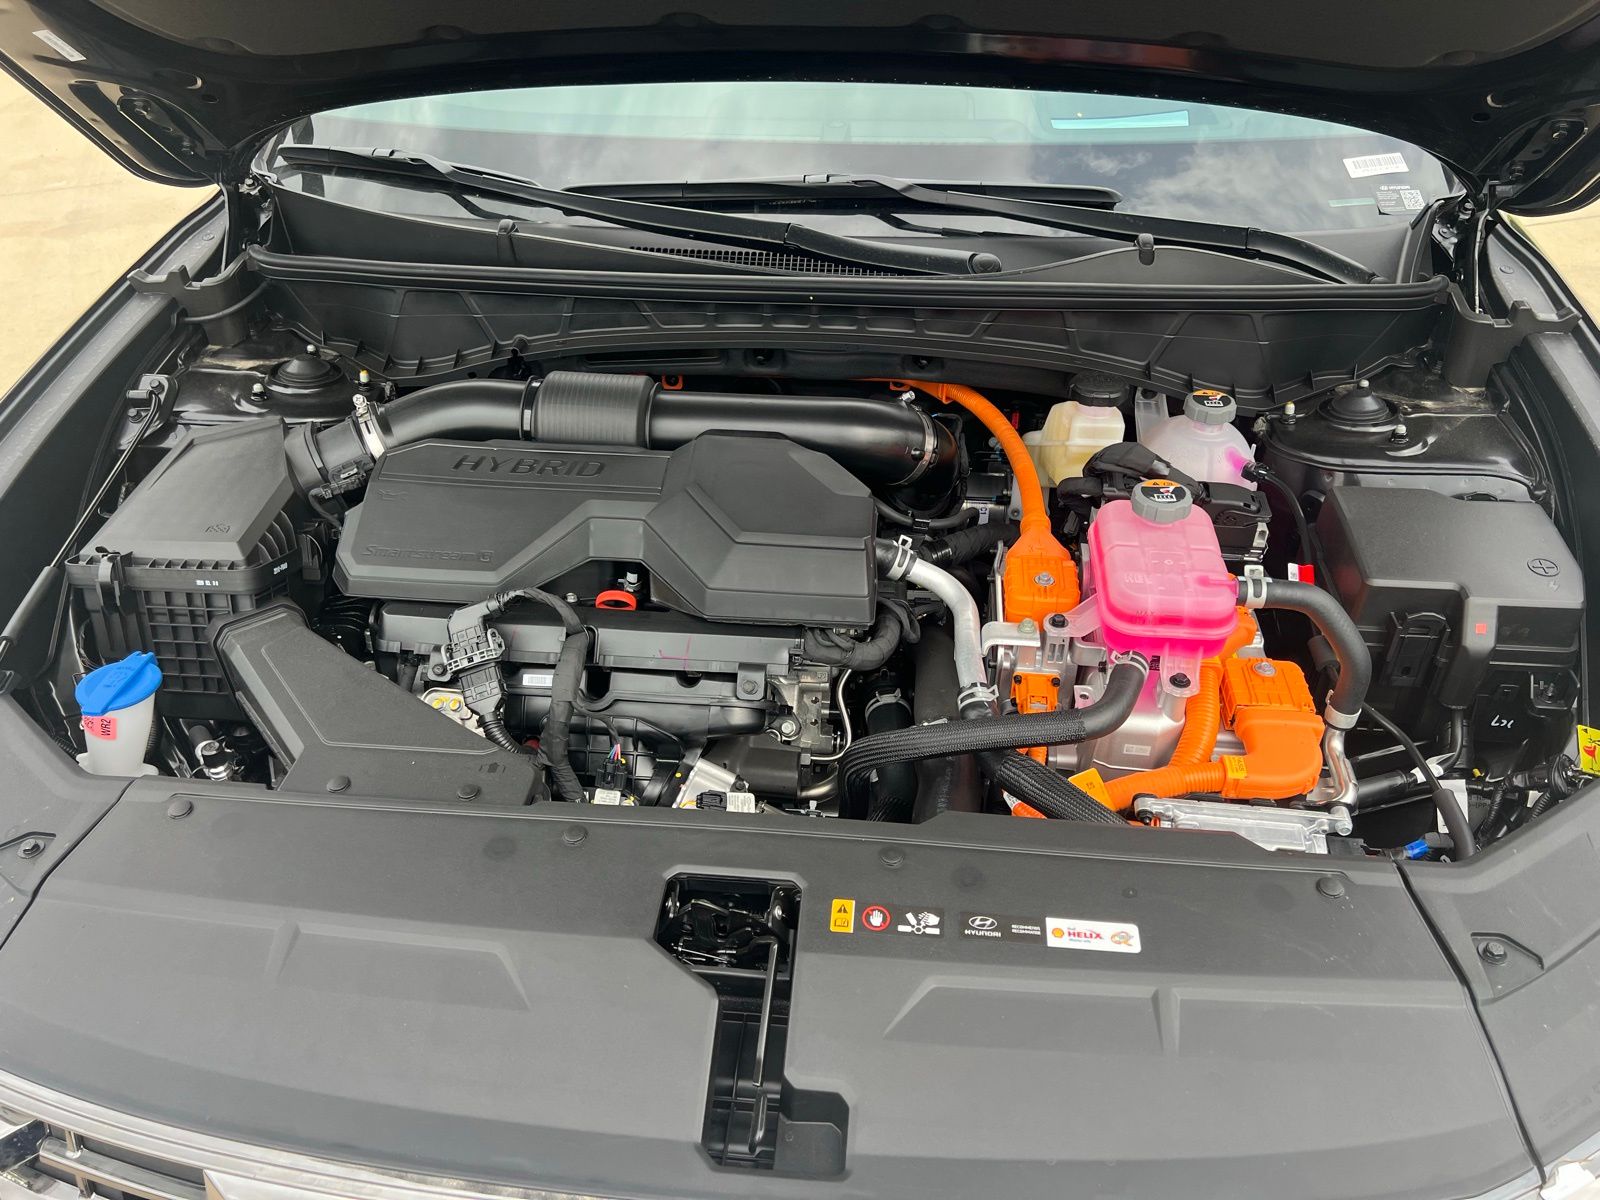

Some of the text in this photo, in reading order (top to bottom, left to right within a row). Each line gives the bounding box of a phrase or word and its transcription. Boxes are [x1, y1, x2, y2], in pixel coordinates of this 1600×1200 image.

[451, 454, 606, 477] HYBRID
[100, 718, 111, 736] WR2
[964, 929, 1001, 938] HYUNDAI
[1067, 931, 1104, 940] HELIX
